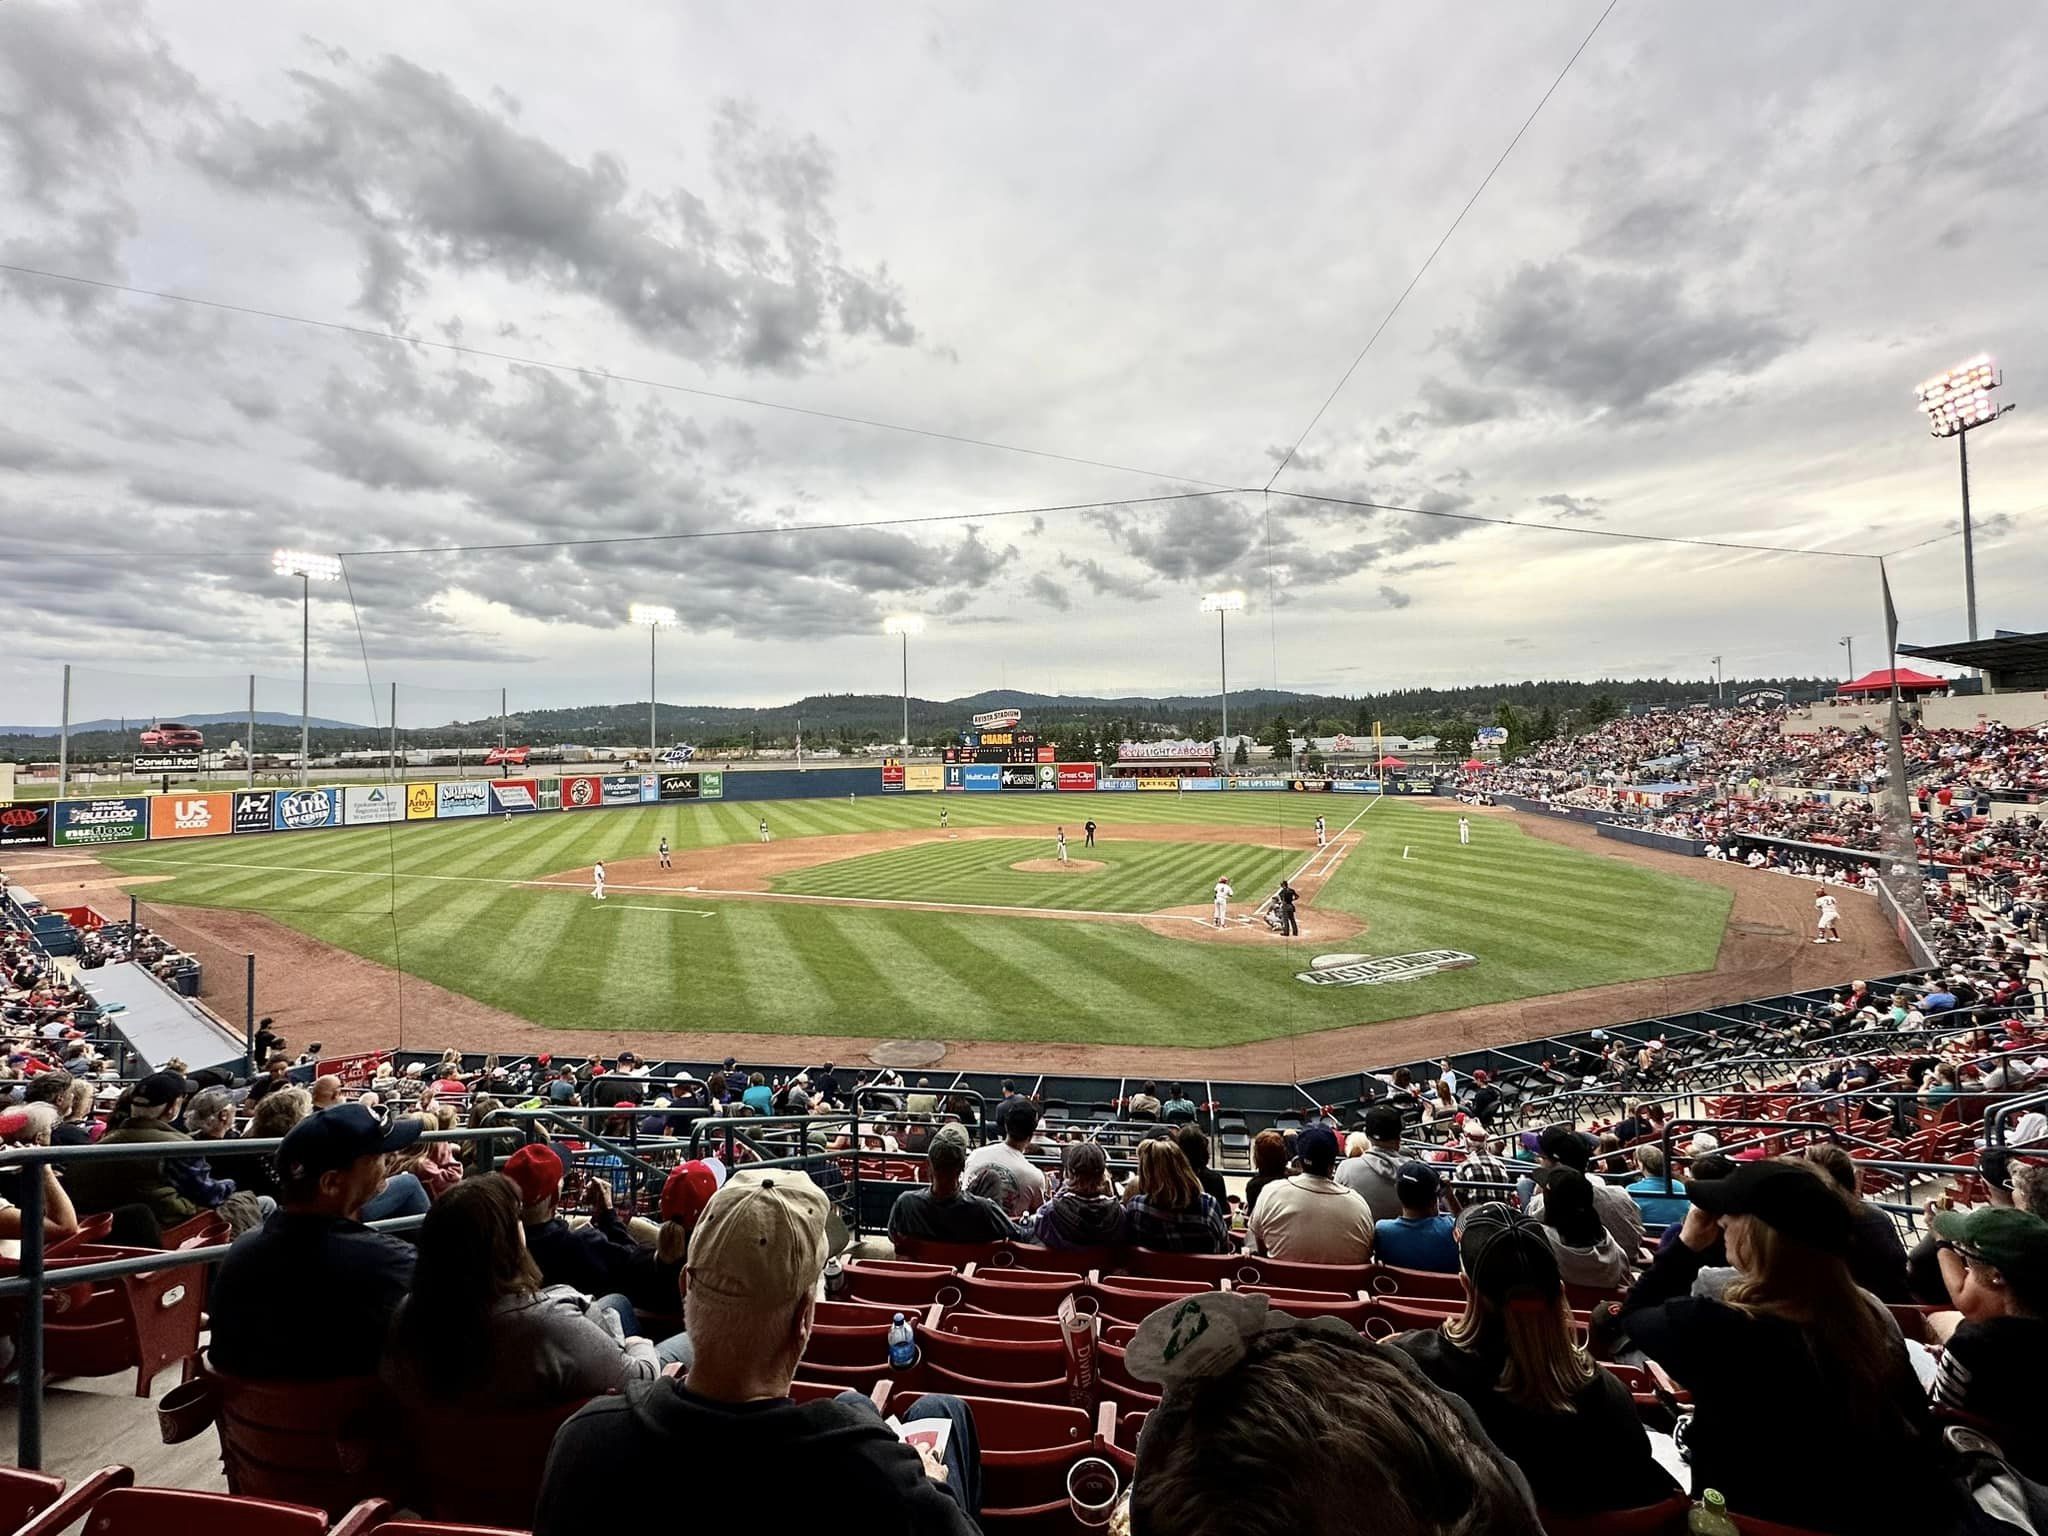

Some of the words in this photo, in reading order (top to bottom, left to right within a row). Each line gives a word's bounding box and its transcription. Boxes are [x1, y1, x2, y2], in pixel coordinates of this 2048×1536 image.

[993, 711, 1019, 719] STADIUM
[981, 733, 1013, 745] CHARGE
[671, 750, 686, 758] TDS
[135, 757, 172, 766] Corwin
[177, 757, 199, 766] Ford
[666, 780, 692, 790] MAX
[409, 799, 434, 808] Arby's
[6, 810, 33, 825] AAA
[80, 809, 138, 820] BULLDOG
[175, 820, 209, 829] FOODS
